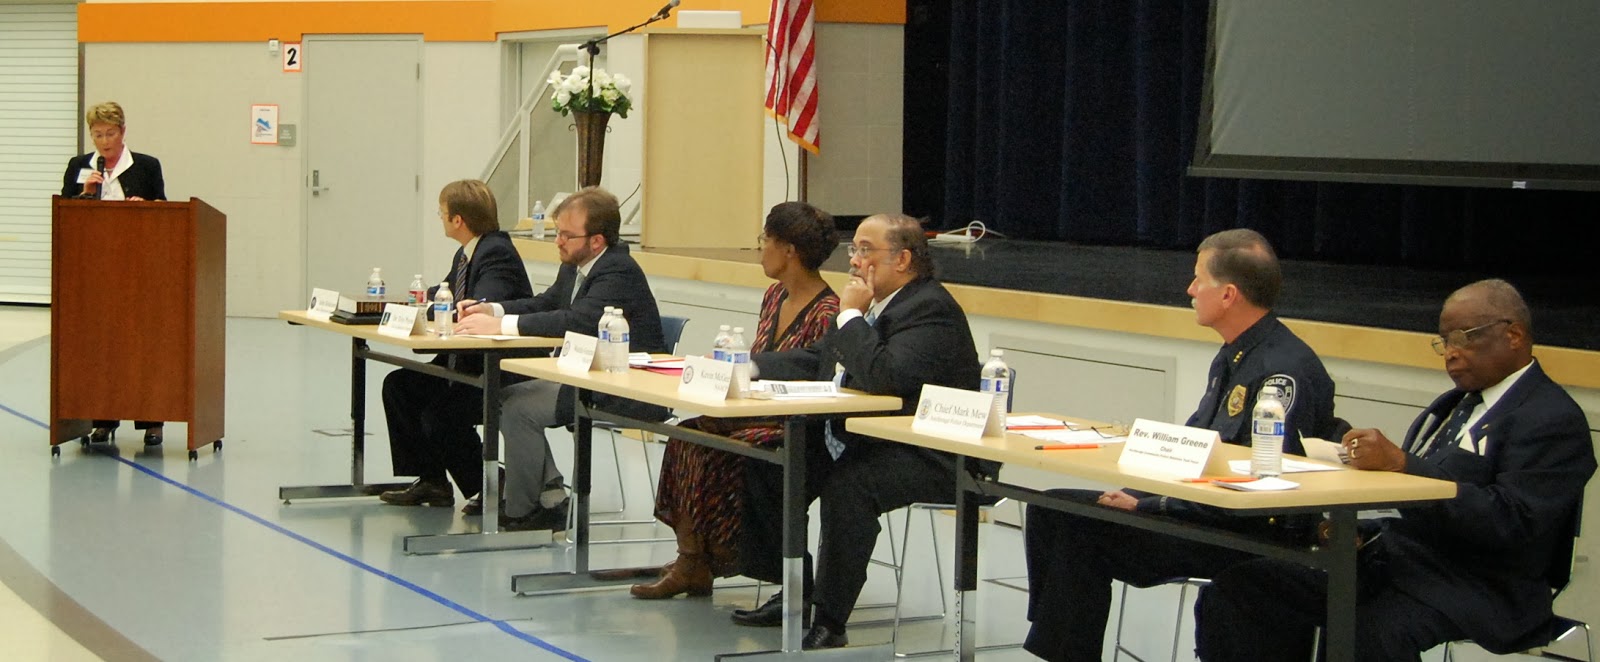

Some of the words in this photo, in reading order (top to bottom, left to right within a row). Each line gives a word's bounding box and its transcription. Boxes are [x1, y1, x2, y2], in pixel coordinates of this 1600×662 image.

[286, 47, 297, 66] 2
[1264, 378, 1288, 387] POLICE
[934, 403, 953, 414] Chief
[953, 405, 969, 416] Mark
[1133, 428, 1150, 439] Rev.
[1152, 431, 1179, 444] William
[1180, 436, 1209, 449] Greene
